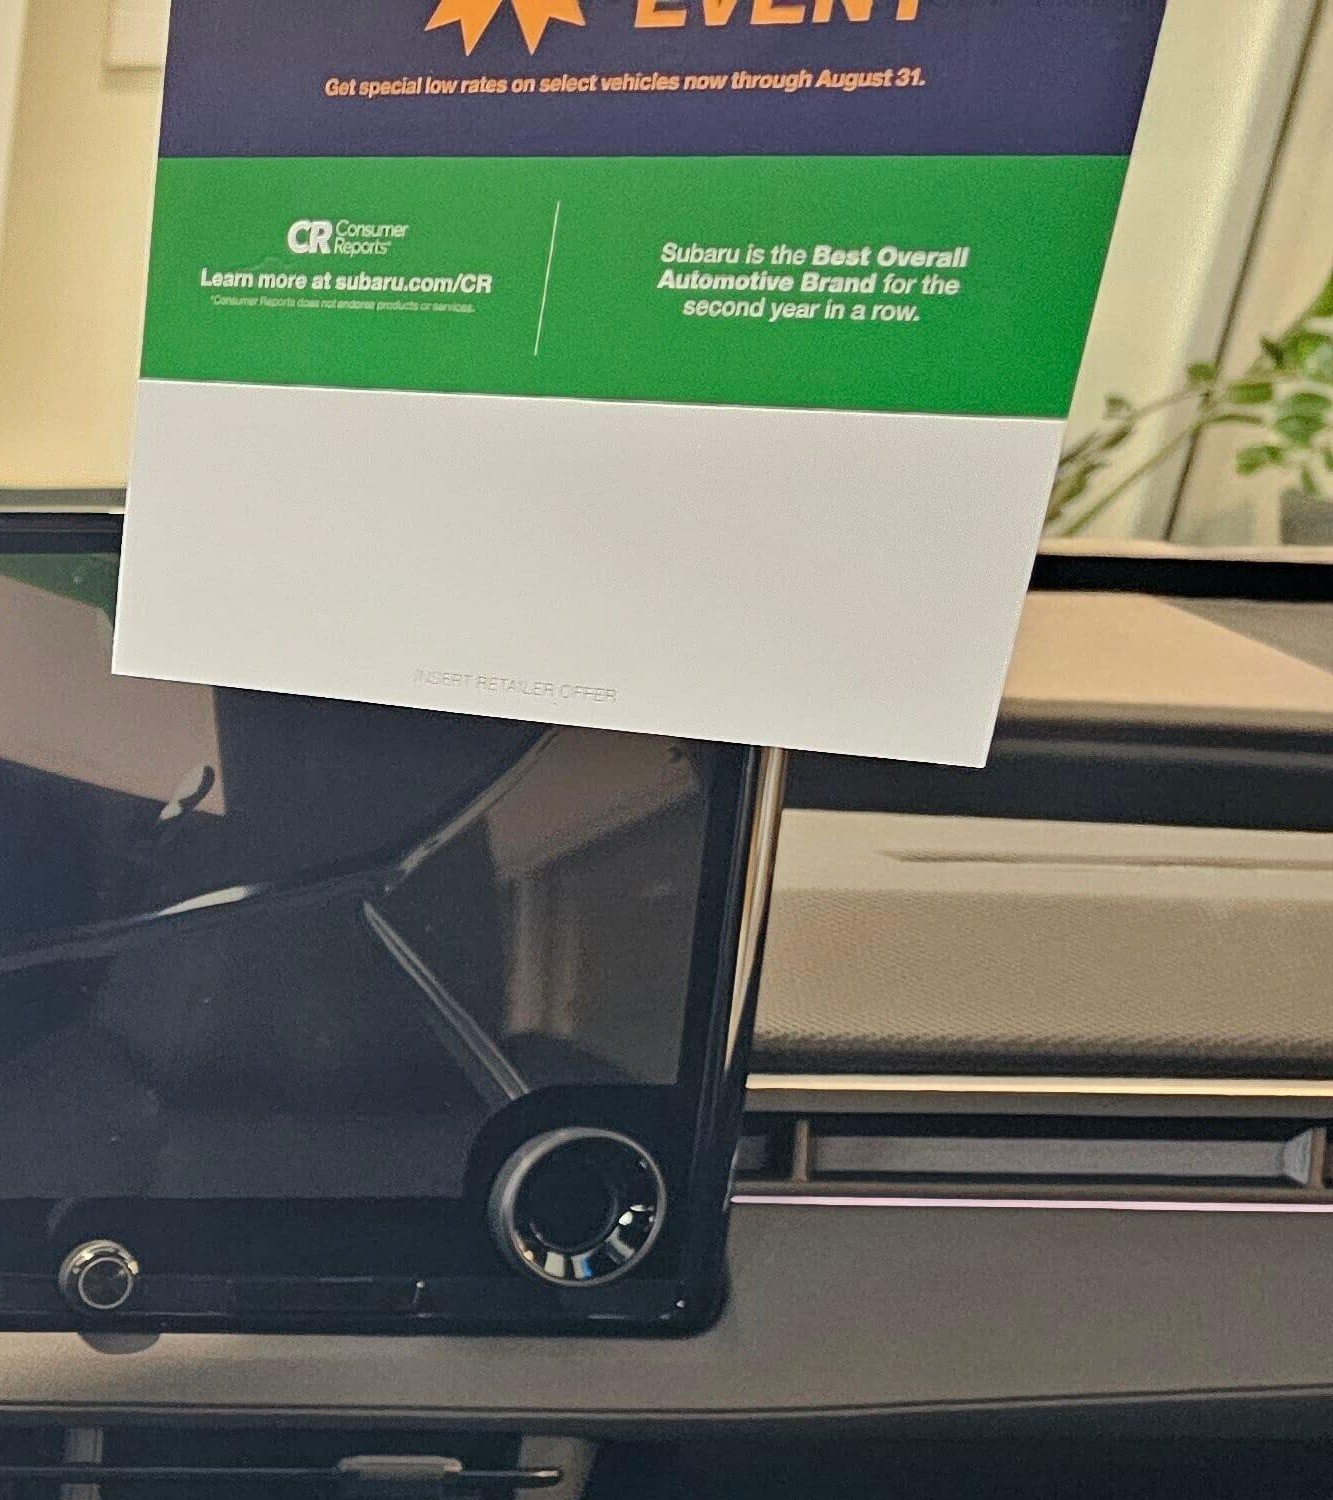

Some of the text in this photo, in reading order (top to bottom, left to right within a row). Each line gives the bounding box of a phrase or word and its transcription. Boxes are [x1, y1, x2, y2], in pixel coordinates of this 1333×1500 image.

[324, 68, 926, 99] Get special low rates on select vehicles now through August 31.
[286, 218, 333, 254] CR
[334, 219, 409, 239] Consumer
[660, 241, 970, 269] Subaru is the Best Overall
[200, 267, 493, 294] Learn more at subaru.com/CR
[657, 268, 961, 296] Automotive Brand for the
[682, 297, 920, 323] second year in a row.
[559, 684, 617, 703] OFFER
